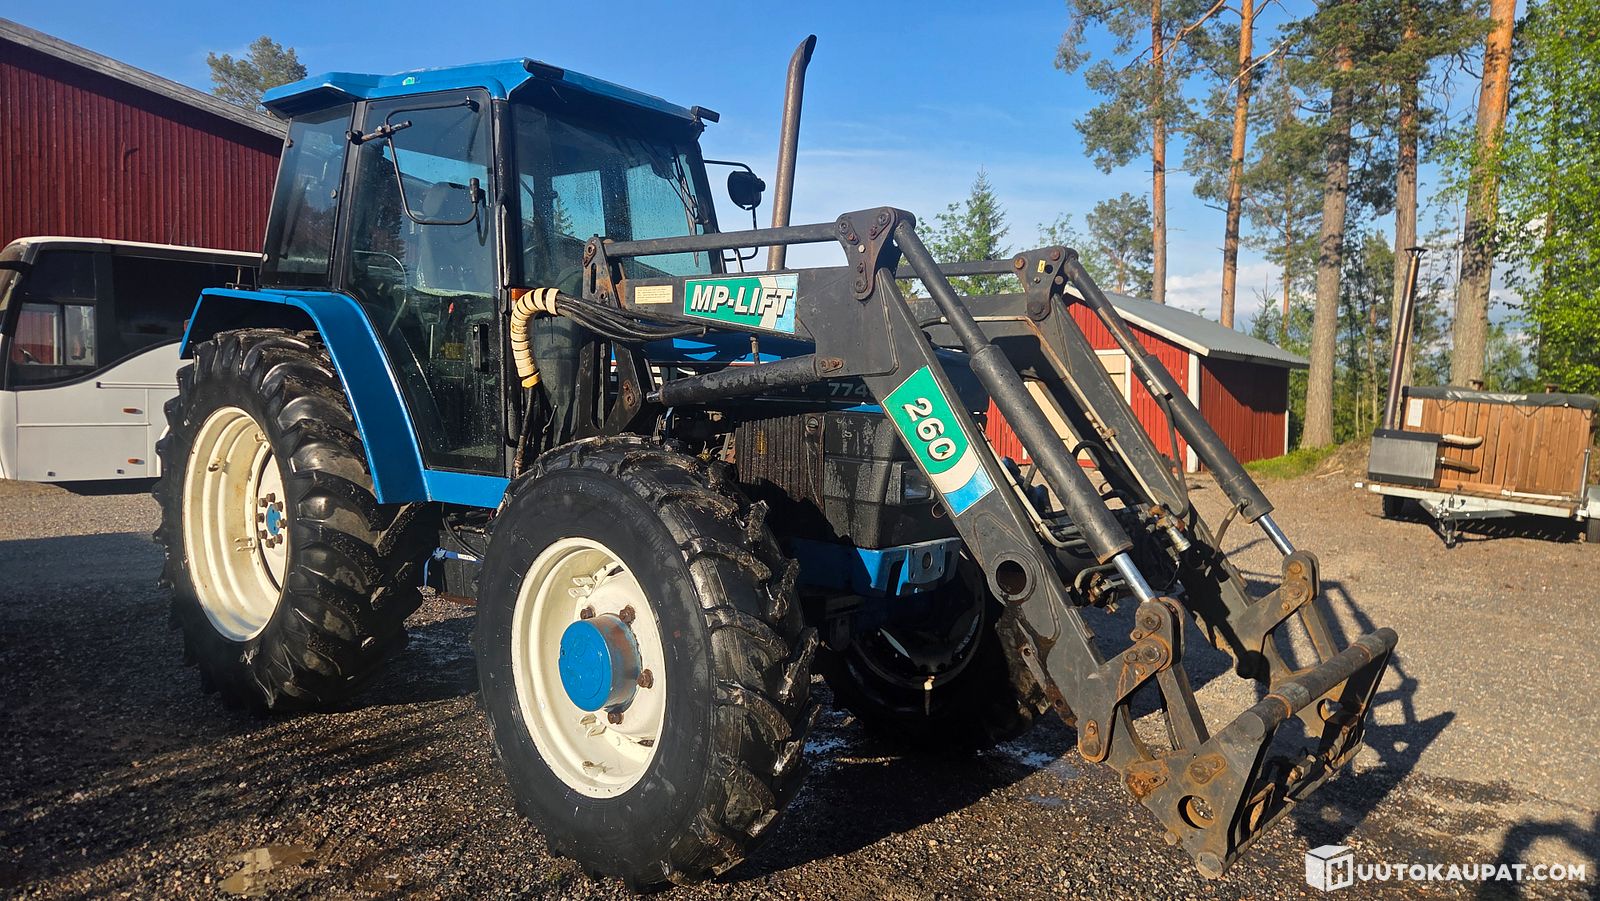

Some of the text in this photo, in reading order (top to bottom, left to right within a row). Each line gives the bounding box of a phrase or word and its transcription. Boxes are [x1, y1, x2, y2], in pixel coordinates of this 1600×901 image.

[691, 285, 794, 317] MP-LIFT
[828, 382, 873, 398] 774
[902, 398, 957, 461] 260
